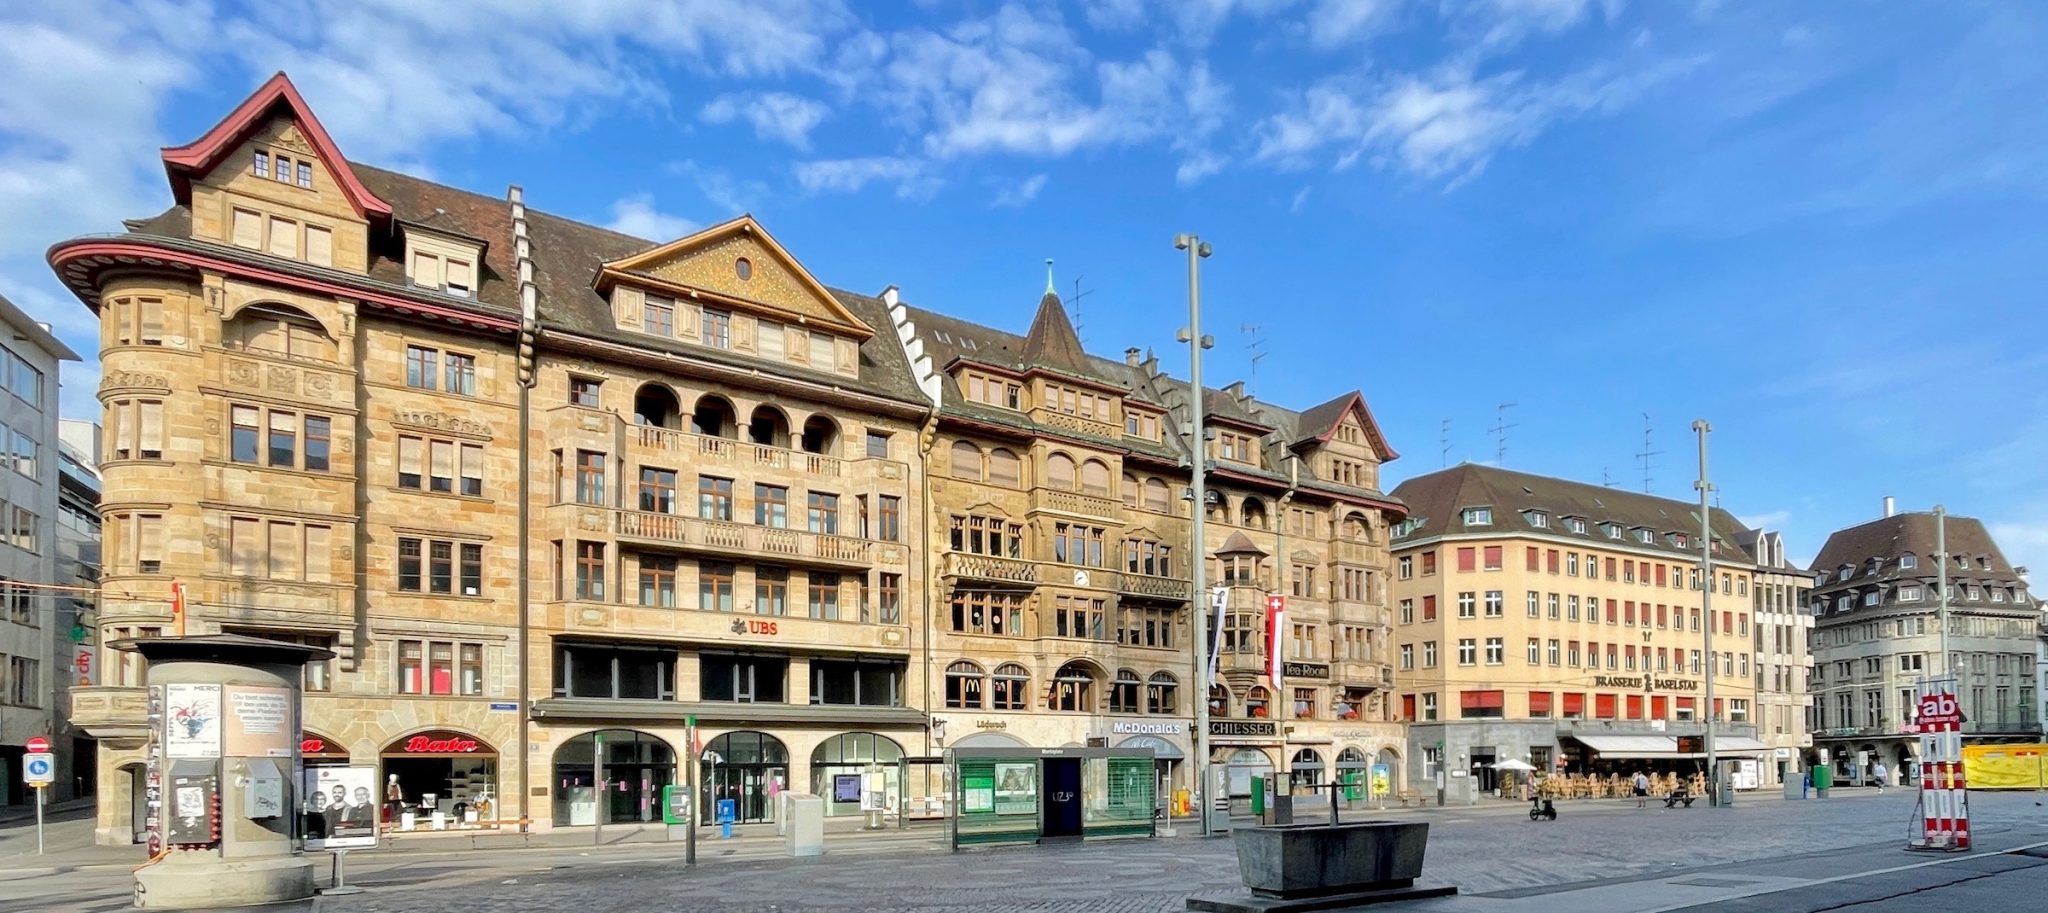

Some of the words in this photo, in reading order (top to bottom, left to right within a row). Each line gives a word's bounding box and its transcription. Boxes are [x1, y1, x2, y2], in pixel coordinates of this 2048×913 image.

[749, 620, 777, 635] UBS
[76, 650, 93, 674] city
[1595, 676, 1642, 688] BRASSERIE
[1654, 679, 1698, 690] BASELSTAB
[1923, 696, 1956, 716] ab
[1113, 722, 1181, 735] McDonald's
[404, 735, 478, 752] Bata
